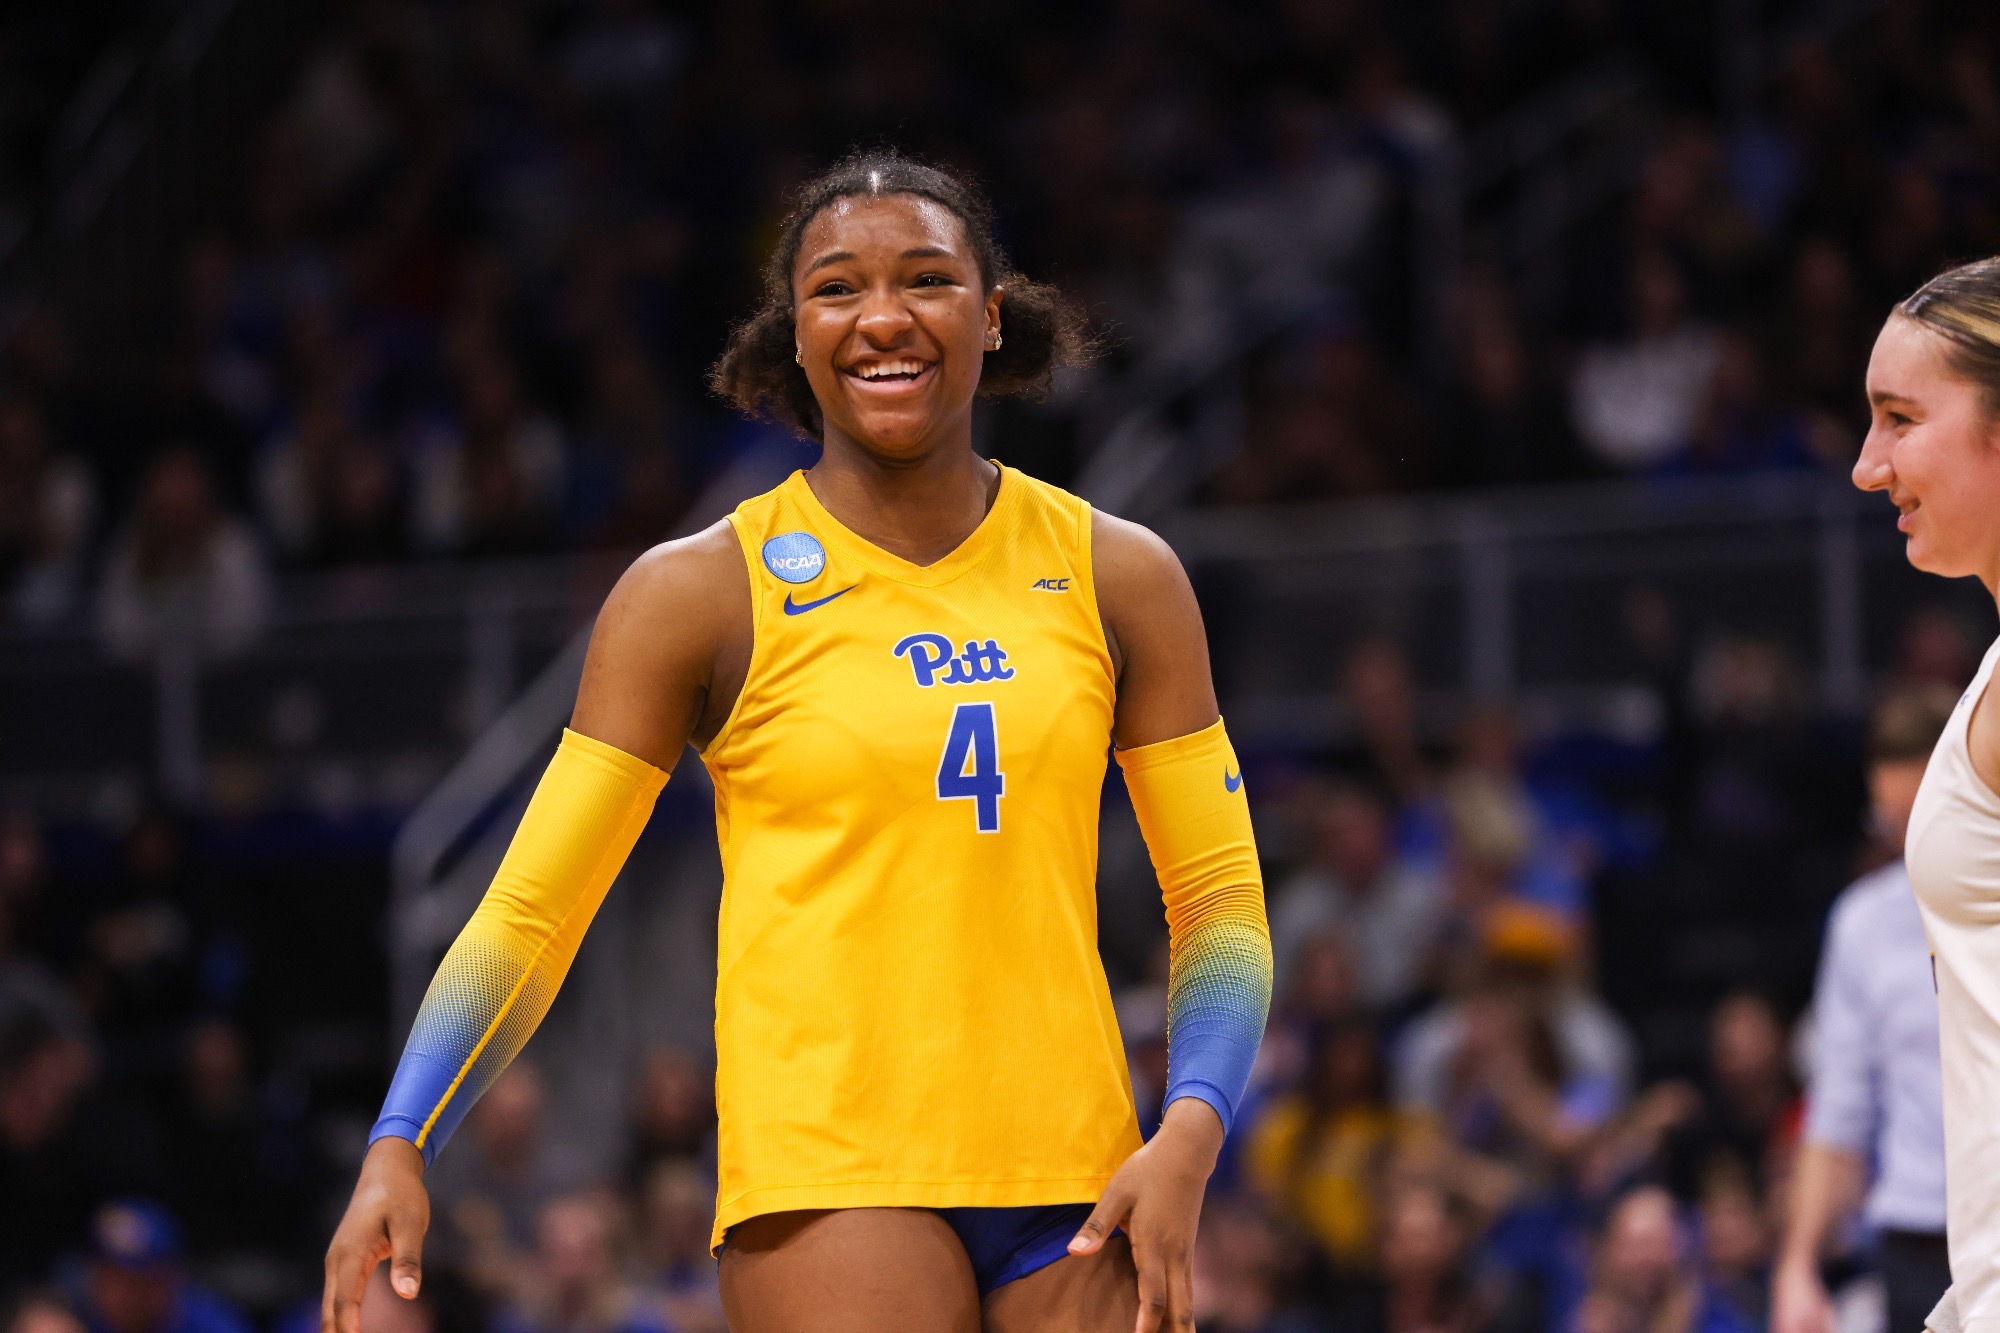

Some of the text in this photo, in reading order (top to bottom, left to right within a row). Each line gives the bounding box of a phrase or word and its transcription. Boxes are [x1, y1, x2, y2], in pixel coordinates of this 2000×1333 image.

[772, 553, 822, 570] NCAA
[1032, 578, 1071, 591] ACC
[892, 632, 1016, 688] Pitt
[935, 701, 1006, 834] 4
